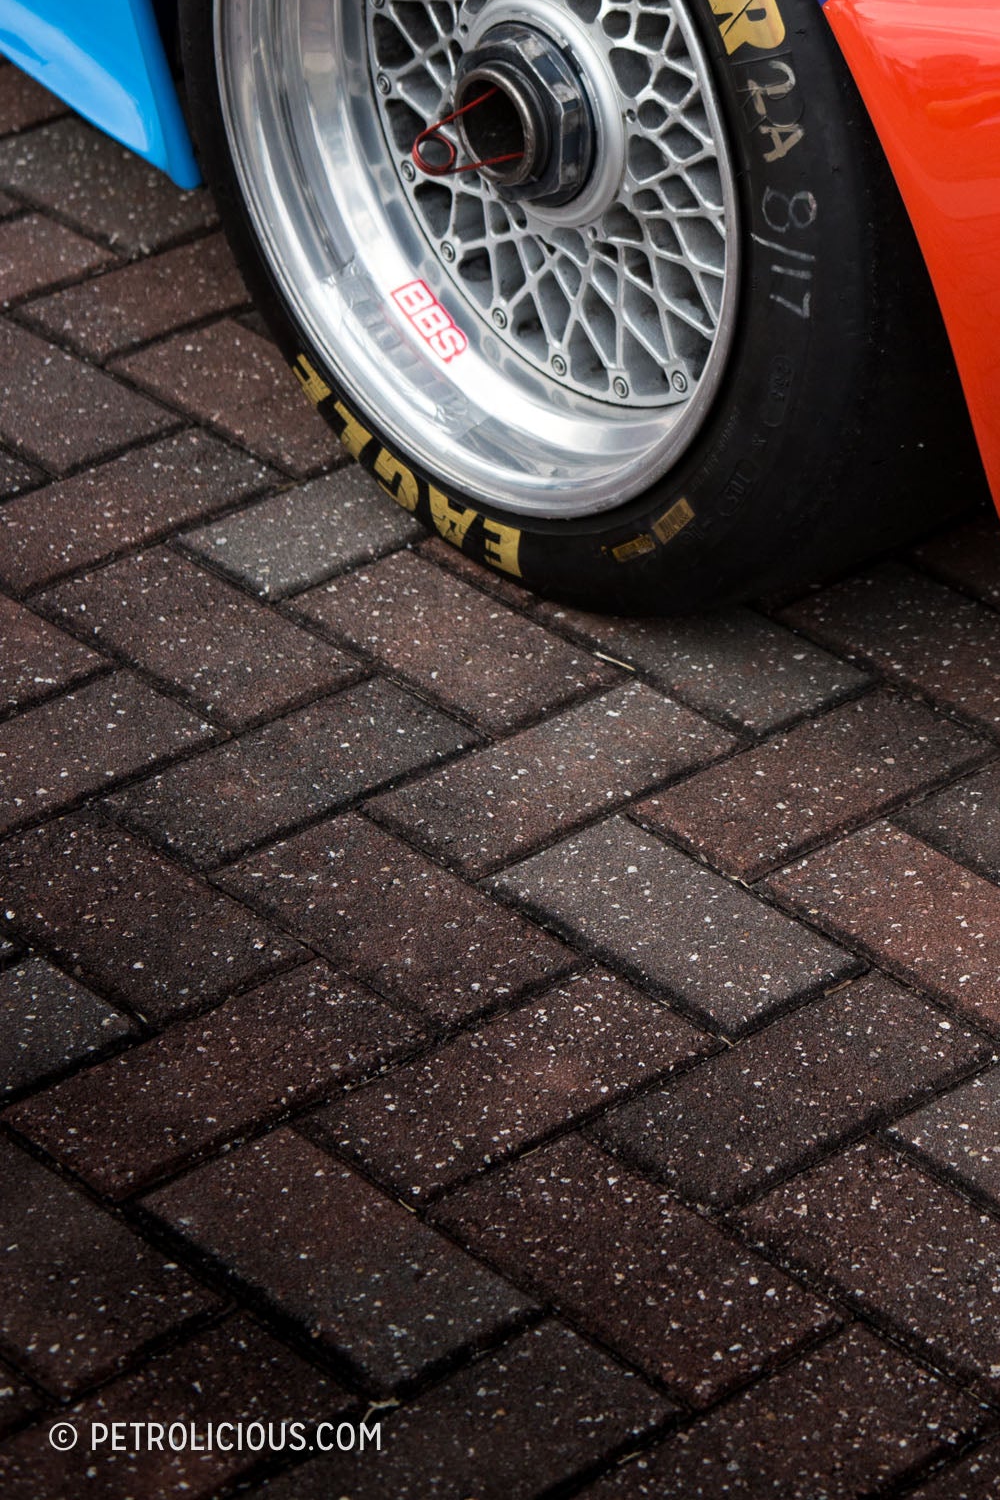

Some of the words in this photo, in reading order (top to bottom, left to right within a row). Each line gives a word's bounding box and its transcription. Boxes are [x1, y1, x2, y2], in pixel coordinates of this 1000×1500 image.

[750, 185, 817, 319] 8/17
[391, 280, 467, 362] BBS
[292, 354, 522, 578] EAGLE
